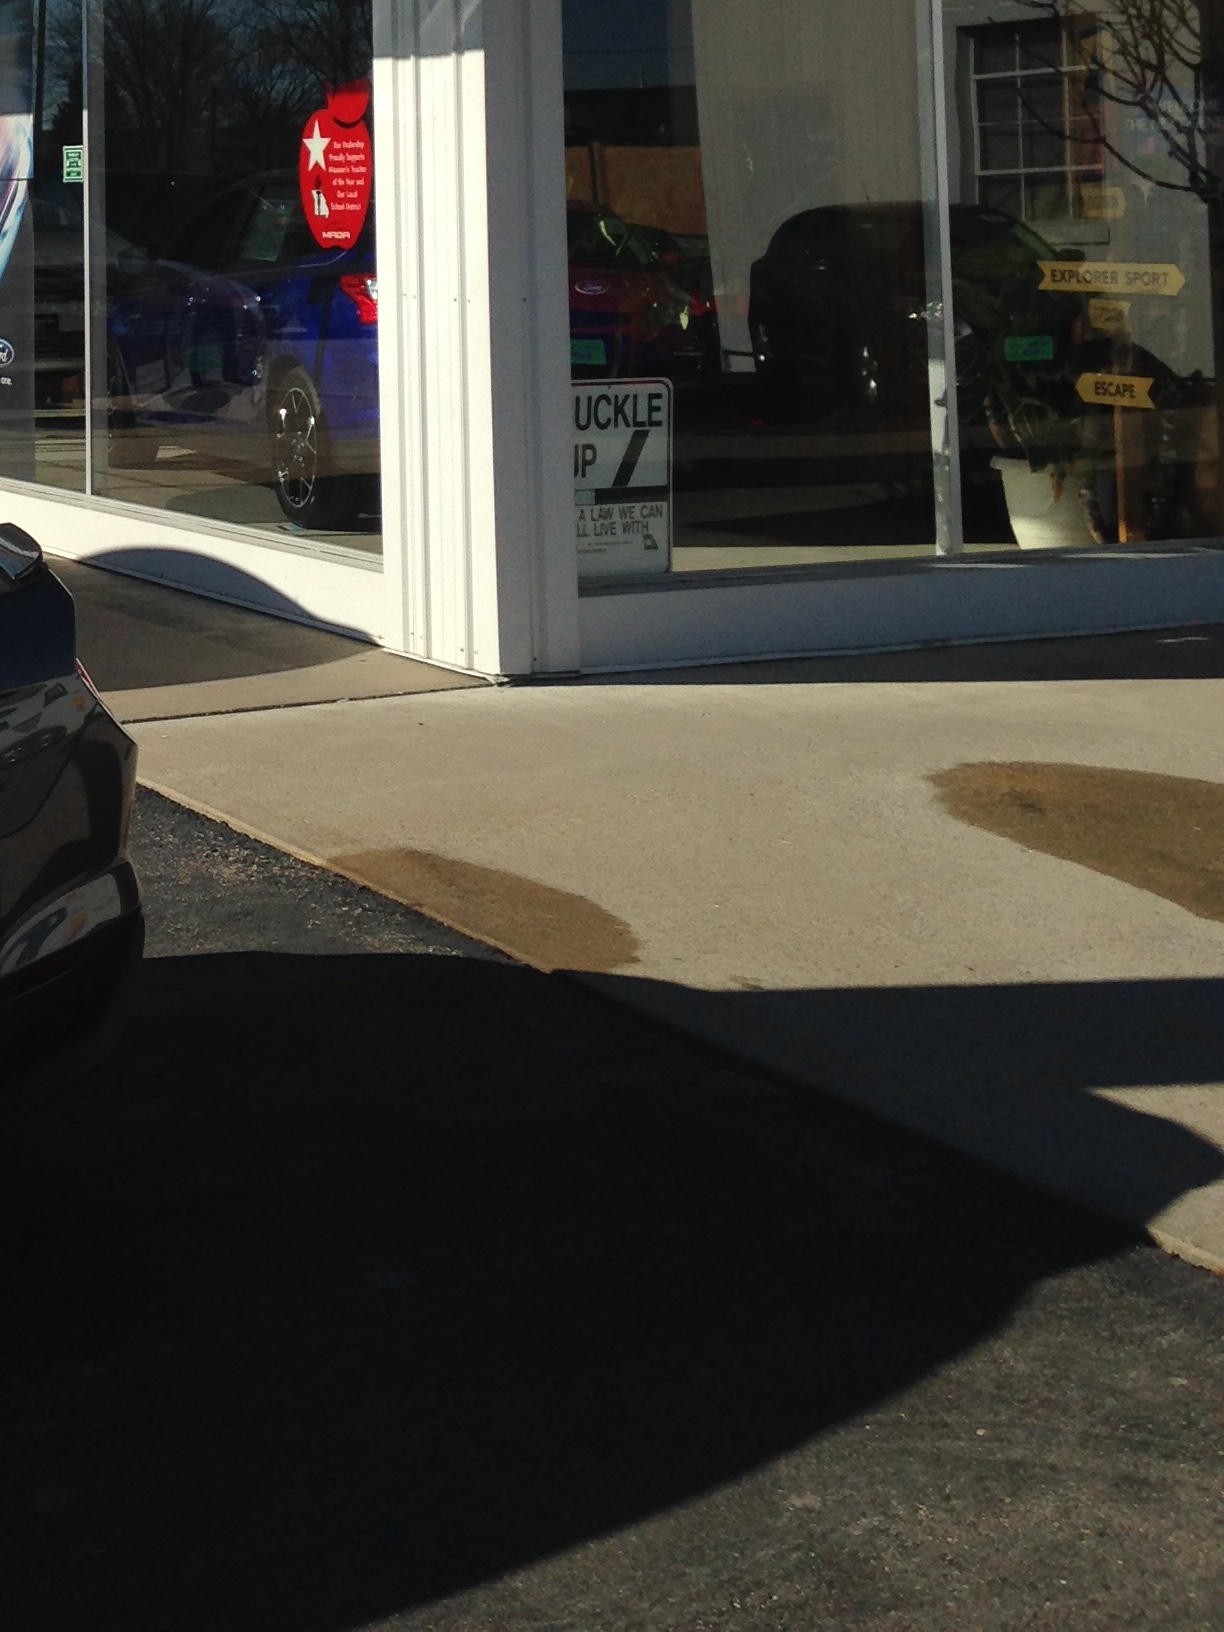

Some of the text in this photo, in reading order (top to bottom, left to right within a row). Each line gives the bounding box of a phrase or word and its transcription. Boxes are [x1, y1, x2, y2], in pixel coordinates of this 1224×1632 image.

[1050, 269, 1169, 287] EXPLORER SPORT
[1094, 380, 1136, 400] ESCAPE
[574, 392, 664, 432] UCKLE
[578, 504, 664, 522] A LAW WE CAN
[576, 520, 649, 537] LL LIVE WITH
